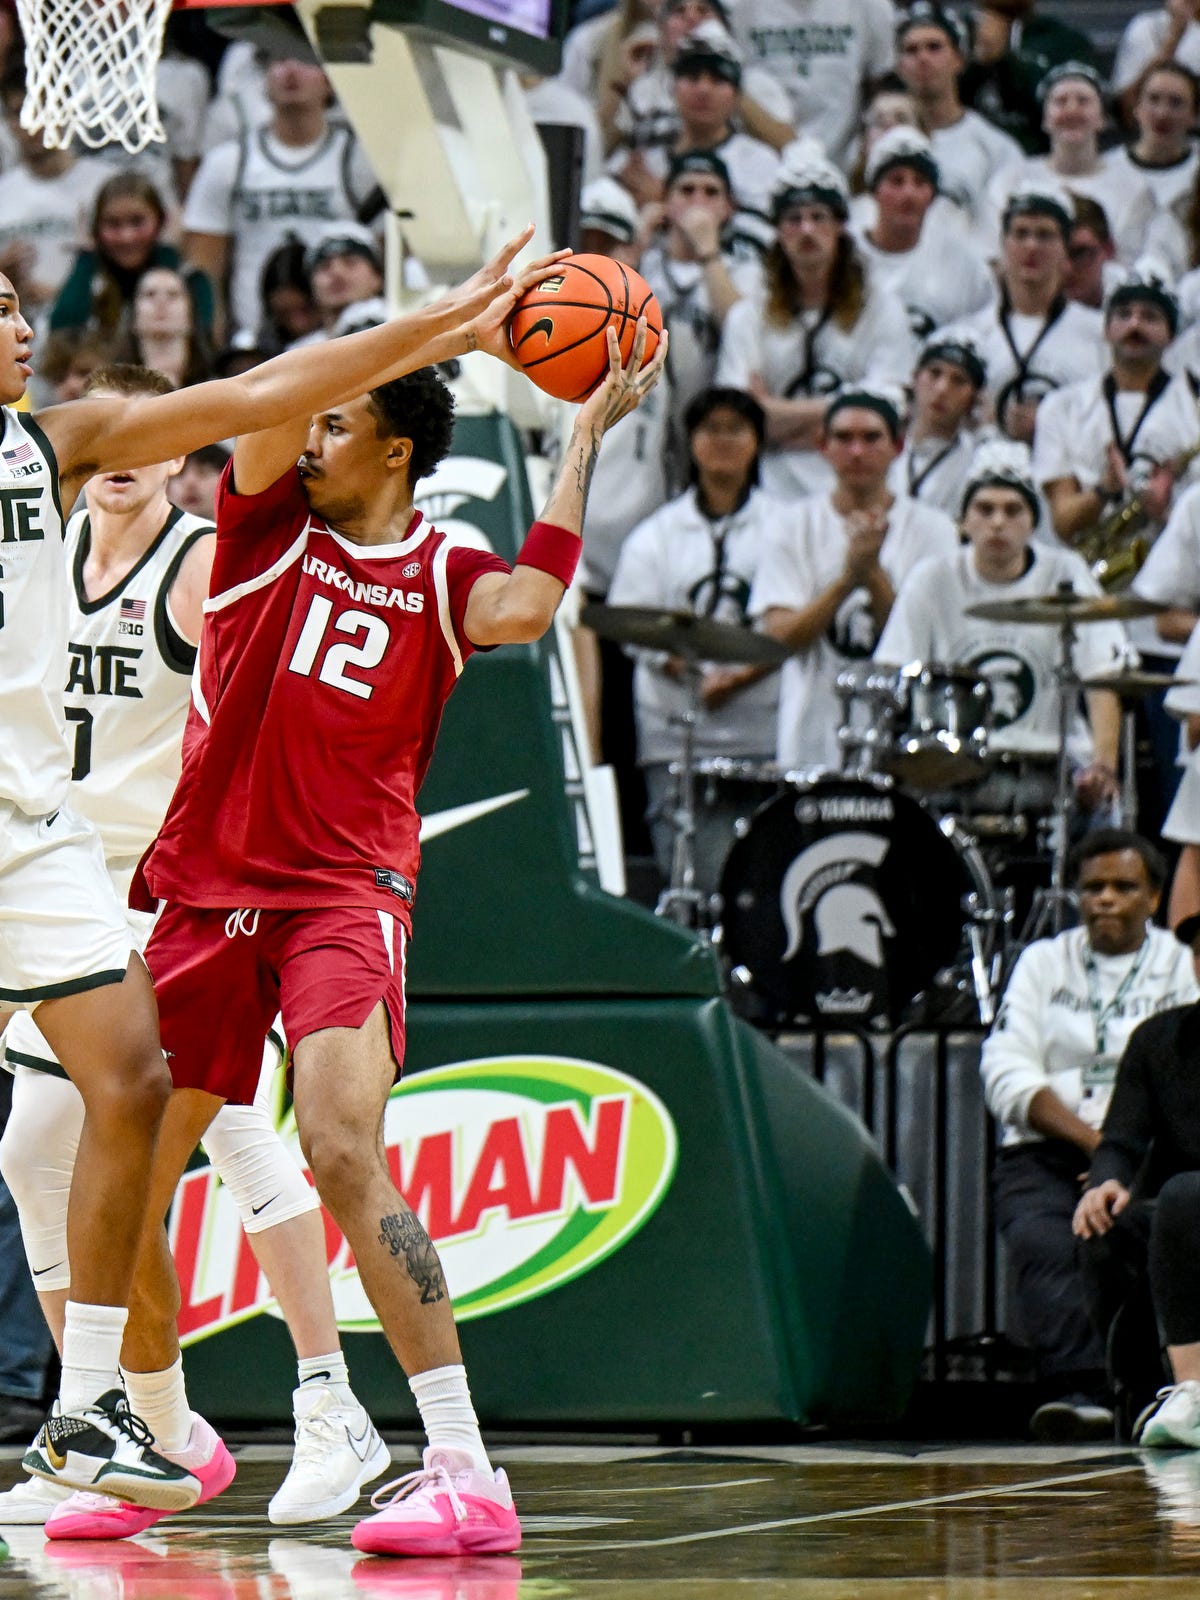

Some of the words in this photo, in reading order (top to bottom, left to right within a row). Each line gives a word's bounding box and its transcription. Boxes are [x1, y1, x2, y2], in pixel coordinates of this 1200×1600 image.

[403, 562, 422, 578] SEC
[64, 641, 144, 699] ATE
[288, 593, 391, 701] 12
